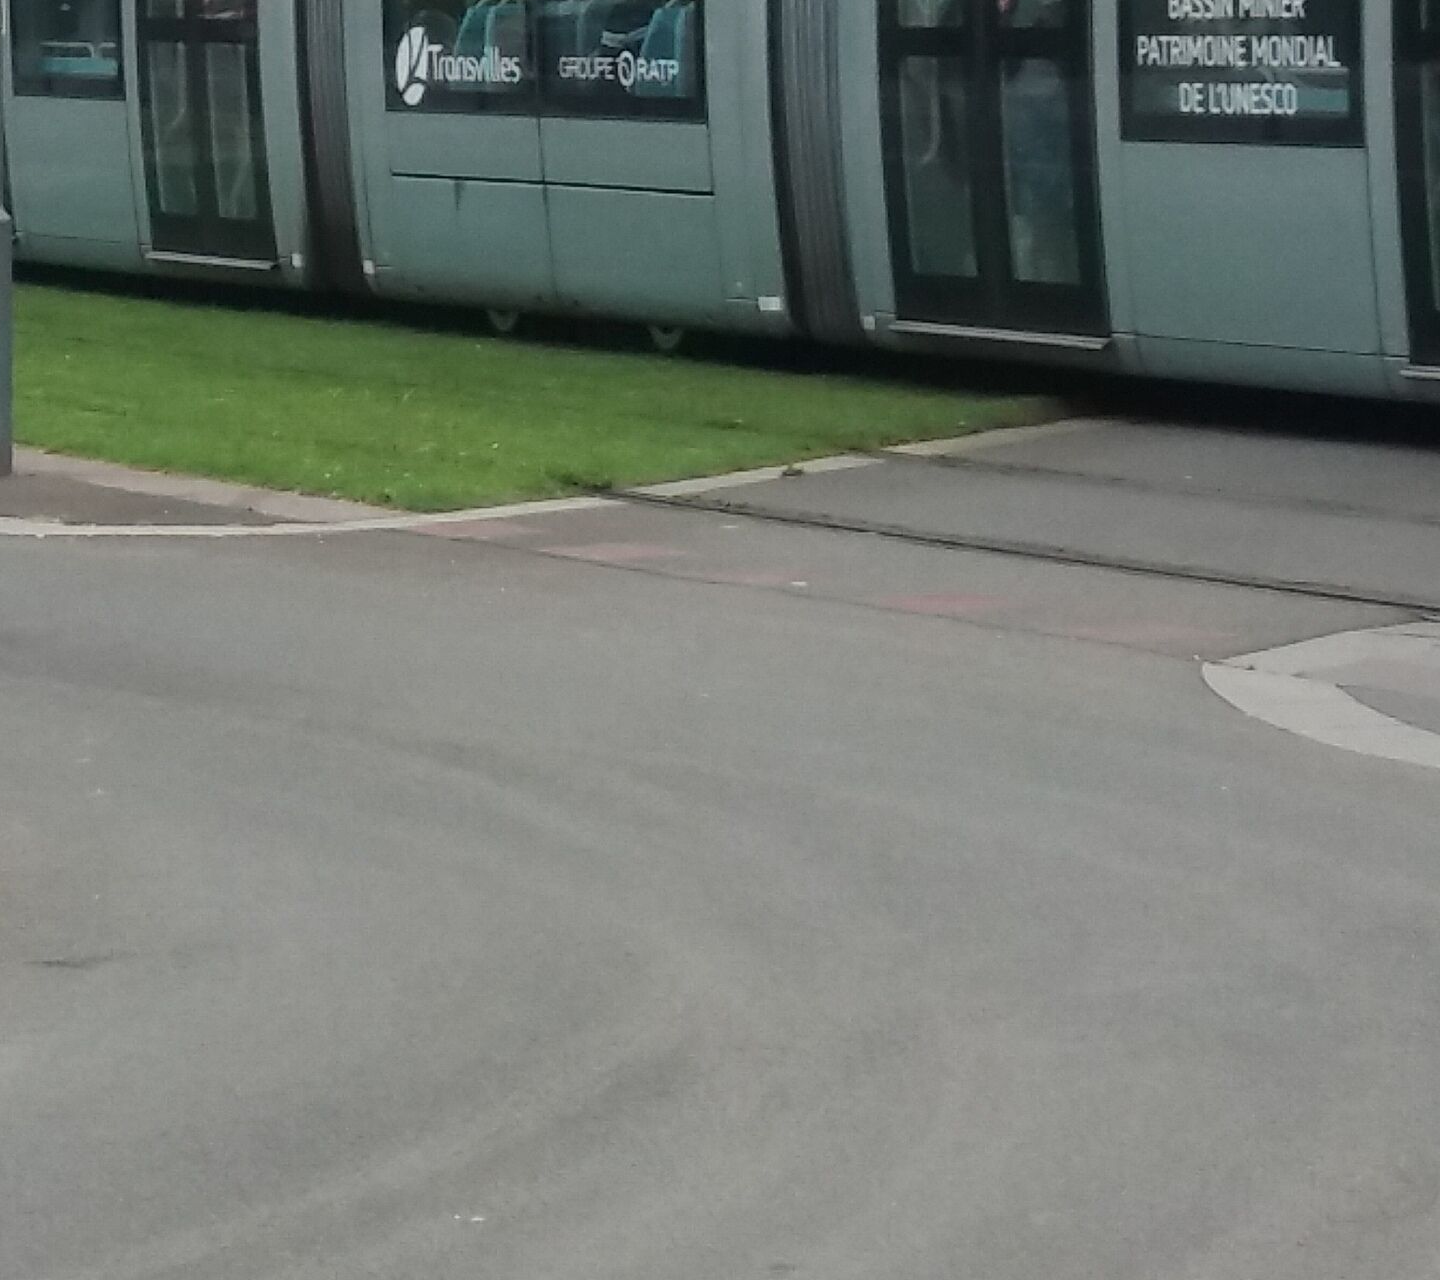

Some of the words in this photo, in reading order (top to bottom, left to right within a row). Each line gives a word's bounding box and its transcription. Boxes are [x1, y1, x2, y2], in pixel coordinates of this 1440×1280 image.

[427, 44, 520, 83] Transvilles
[1136, 35, 1247, 66] PATRIMOINE
[1252, 35, 1342, 67] MONDIAL
[559, 56, 616, 80] GROUPE
[636, 59, 680, 82] RATP
[1178, 82, 1205, 113] DE
[1208, 82, 1298, 115] L'UNESCO
